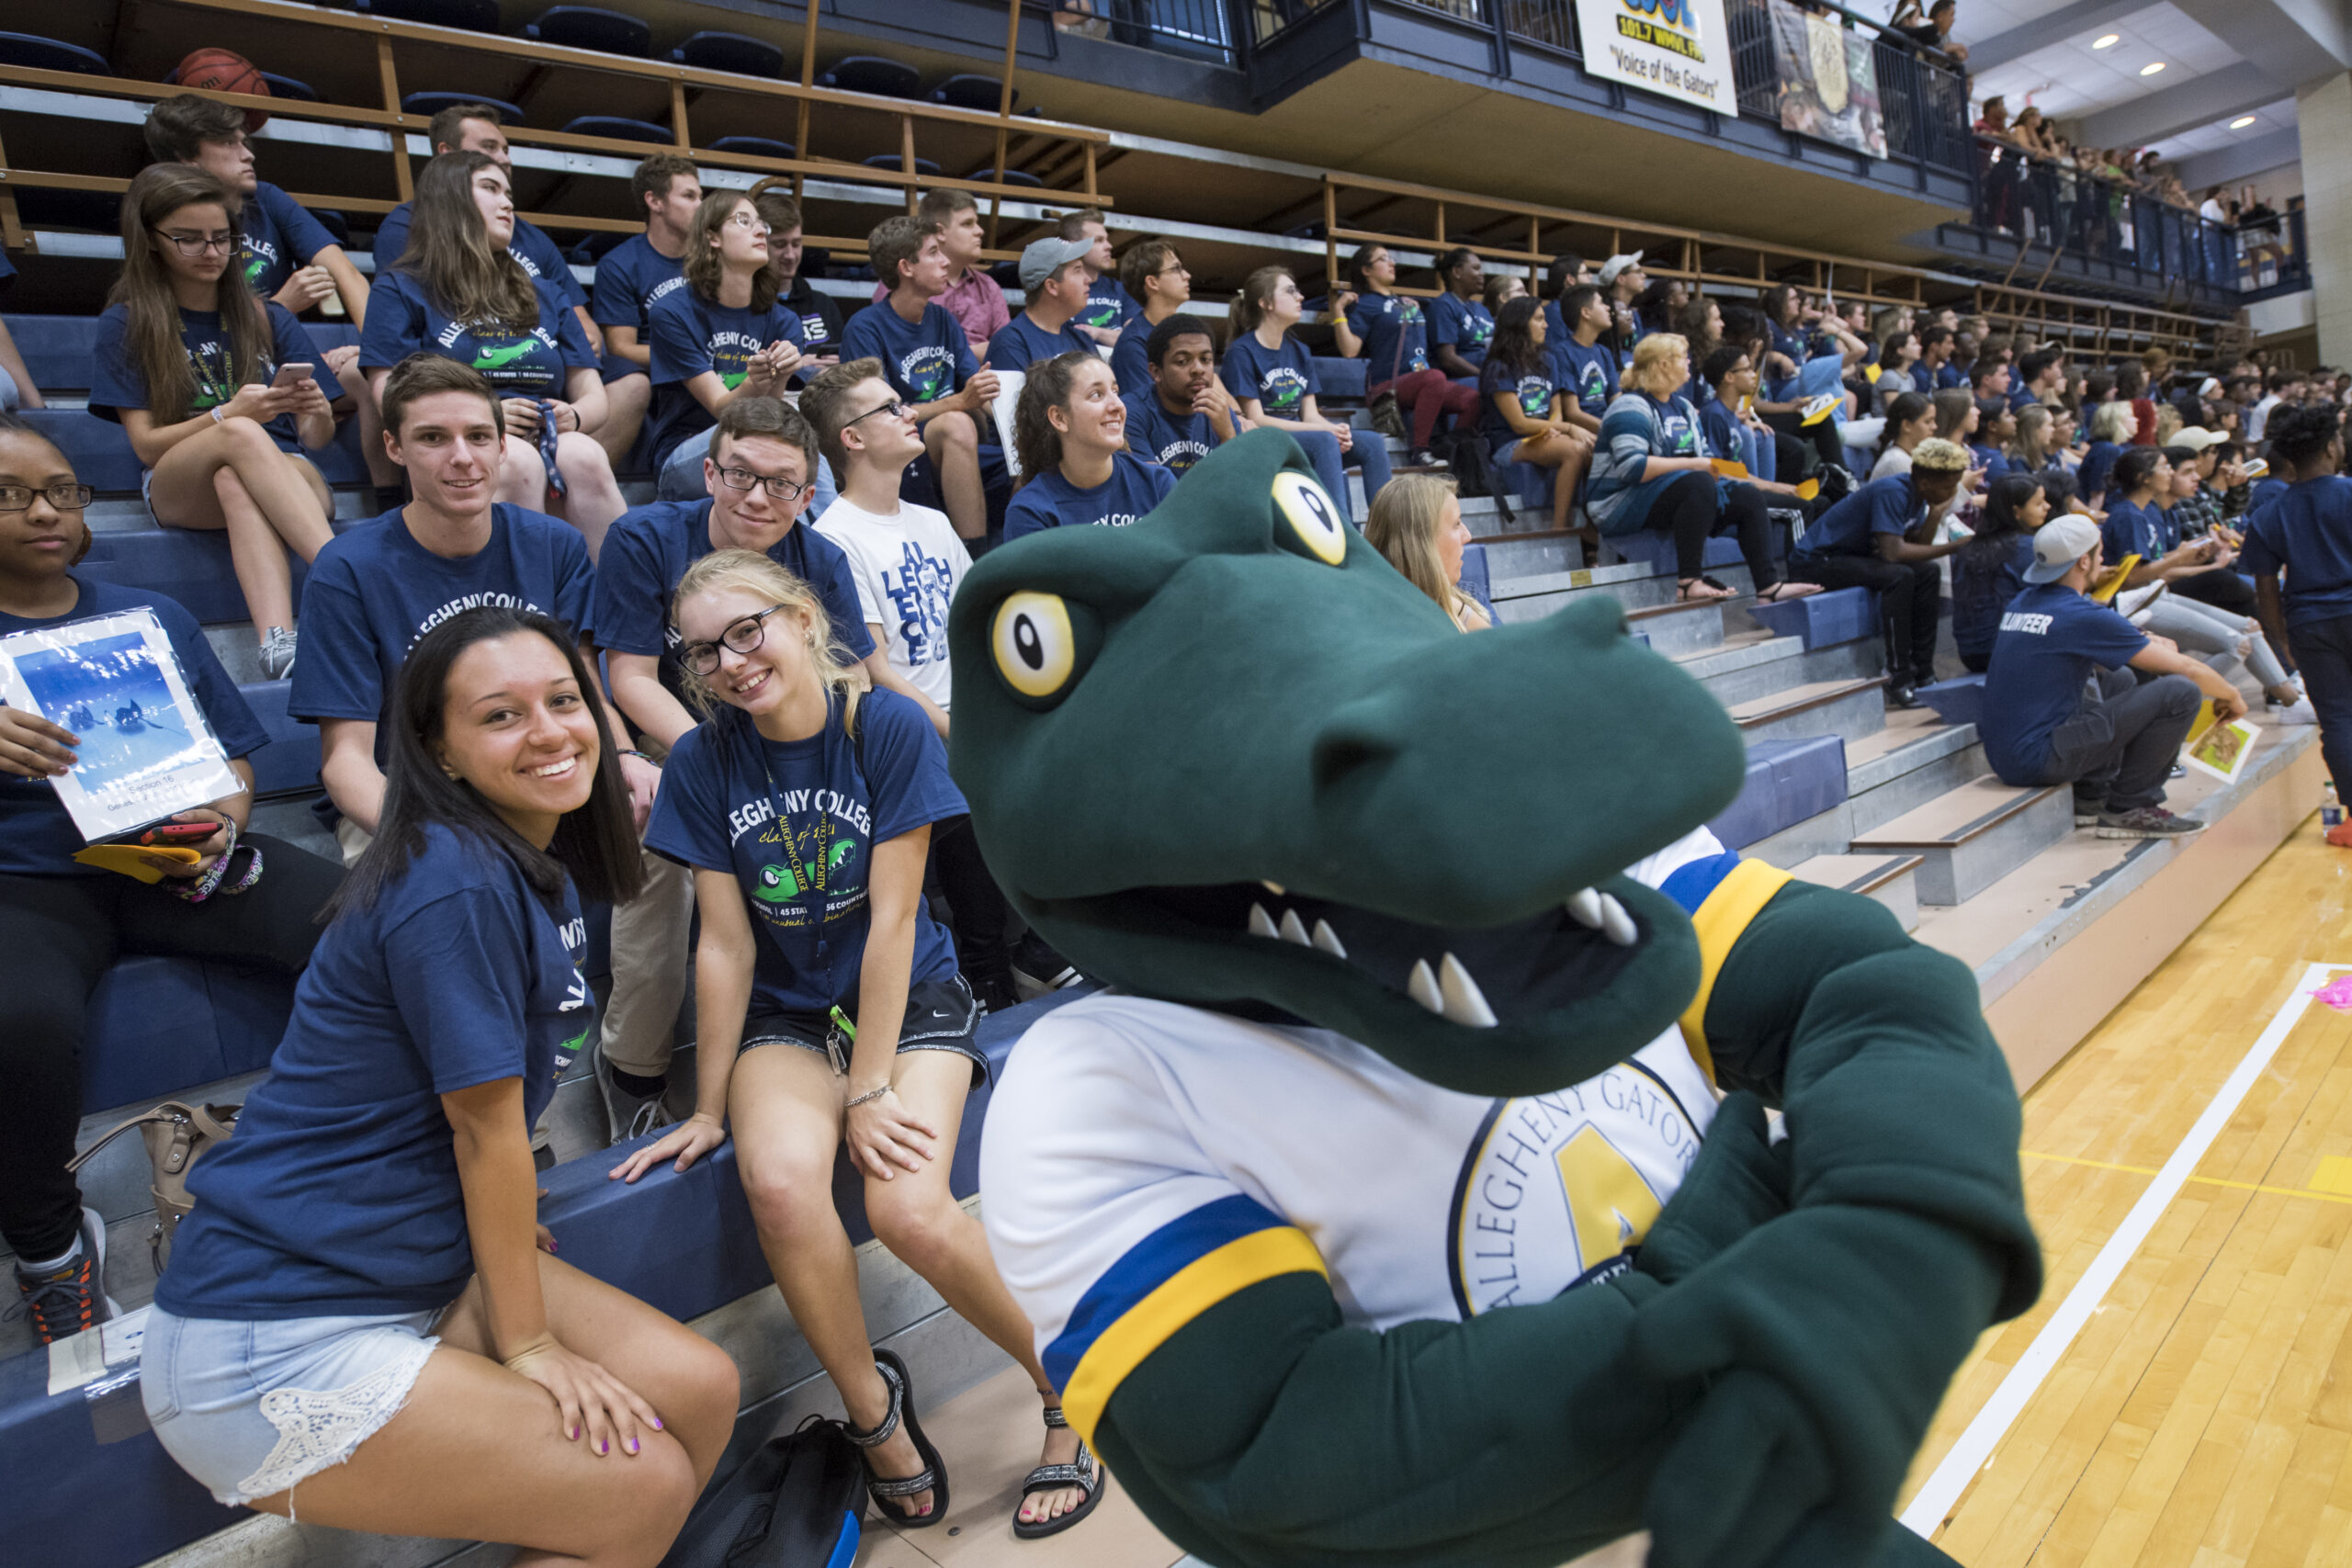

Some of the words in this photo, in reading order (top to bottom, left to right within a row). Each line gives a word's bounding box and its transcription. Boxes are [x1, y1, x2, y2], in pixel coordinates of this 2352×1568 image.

[1620, 17, 1652, 41] 101.7
[1610, 44, 1646, 77] "Voice
[1650, 59, 1661, 81] of
[1664, 62, 1680, 89] the
[1683, 69, 1719, 100] Gators"
[797, 823, 811, 851] of
[780, 908, 790, 916] 45
[826, 902, 835, 911] 56
